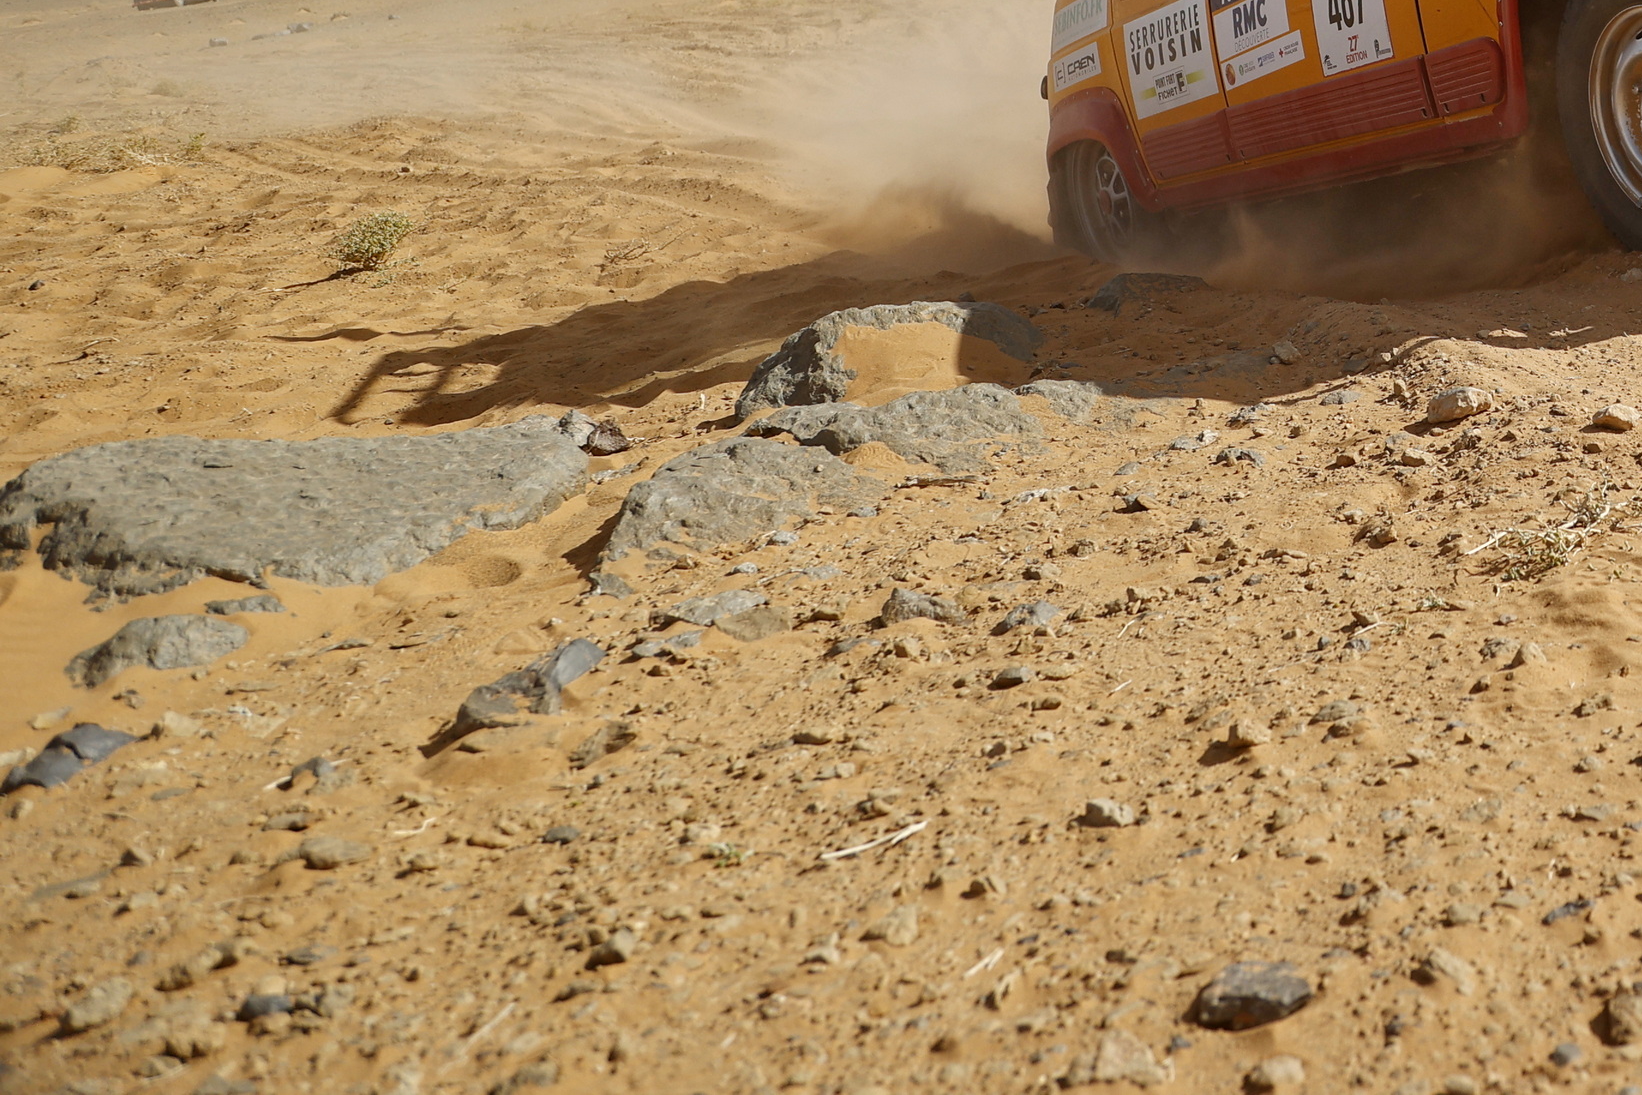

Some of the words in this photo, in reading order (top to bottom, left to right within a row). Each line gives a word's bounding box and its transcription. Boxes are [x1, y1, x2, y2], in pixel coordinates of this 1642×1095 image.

[1129, 3, 1200, 53] SERRURERIE
[1234, 27, 1270, 53] DÉCOUVERTE
[1067, 53, 1095, 75] CAEN
[1130, 27, 1202, 76] VOISIN
